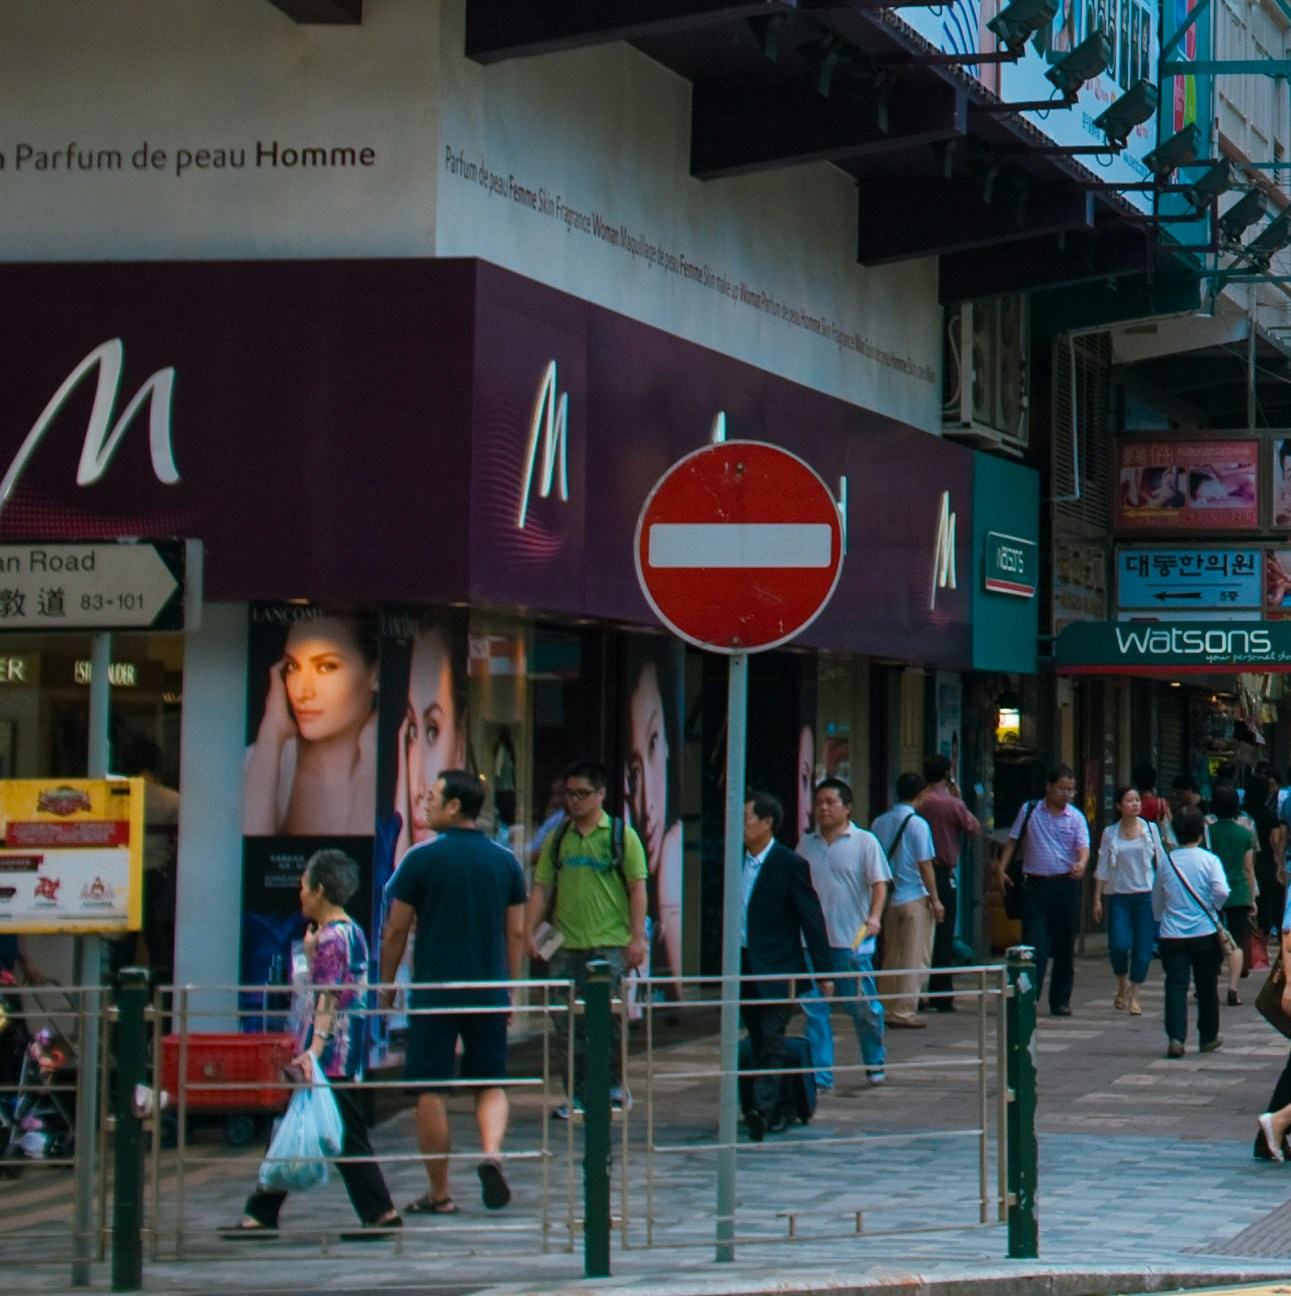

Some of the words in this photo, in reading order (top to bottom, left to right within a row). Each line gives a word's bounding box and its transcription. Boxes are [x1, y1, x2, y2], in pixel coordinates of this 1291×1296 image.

[14, 142, 122, 172] Parfum
[131, 141, 168, 169] de
[174, 146, 246, 176] peau
[255, 142, 376, 168] Homme
[445, 144, 477, 182] Parfum
[489, 171, 508, 197] peau
[509, 174, 536, 211] Femme
[538, 187, 554, 218] Skin
[555, 195, 591, 233] Fragrance
[592, 212, 619, 247] Woman
[29, 550, 95, 572] Road
[1126, 554, 1255, 577] 대동한의원
[80, 593, 144, 611] 83-101
[1116, 627, 1272, 653] Watsons
[1206, 653, 1230, 663] your
[1232, 652, 1275, 663] personal
